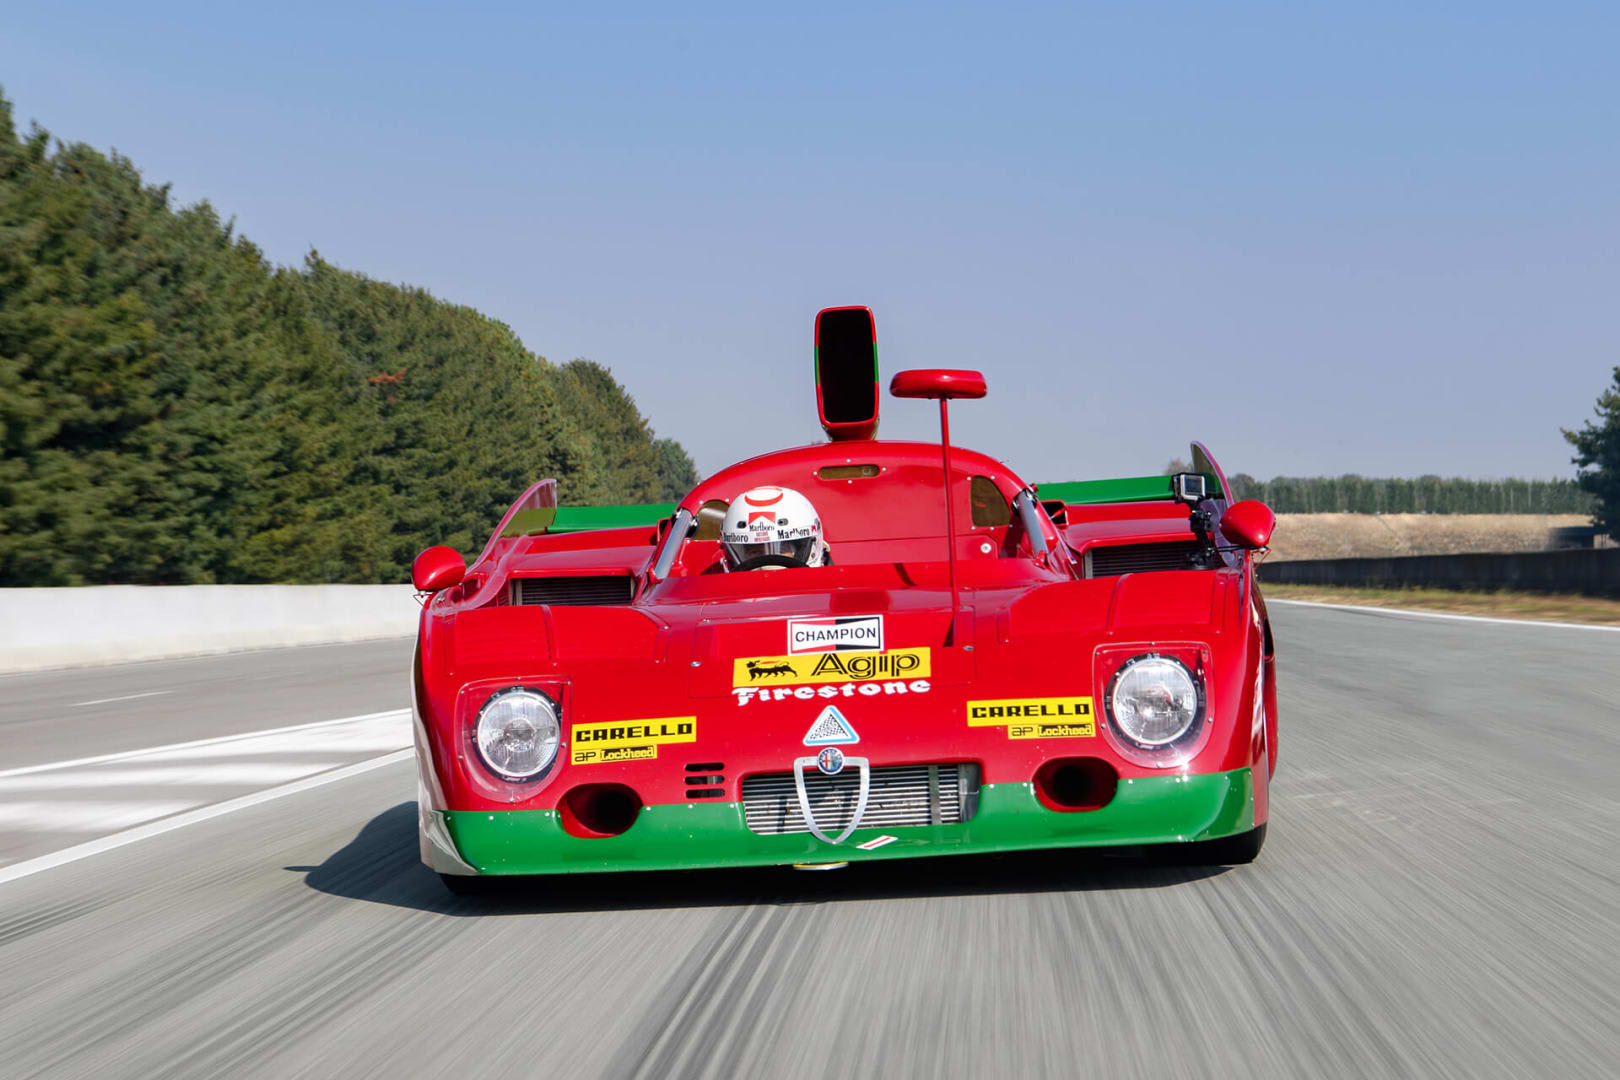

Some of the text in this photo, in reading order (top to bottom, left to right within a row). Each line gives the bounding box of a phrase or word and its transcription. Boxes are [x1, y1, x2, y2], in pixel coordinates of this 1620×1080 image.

[749, 522, 775, 532] Marlboro
[795, 627, 876, 643] CHAMPION
[811, 653, 920, 680] Agip
[732, 680, 931, 706] Firestone
[972, 703, 1089, 718] CARELLO
[576, 723, 692, 742] CARELLO
[1039, 725, 1093, 737] Lockheed
[601, 746, 654, 761] Lockheed
